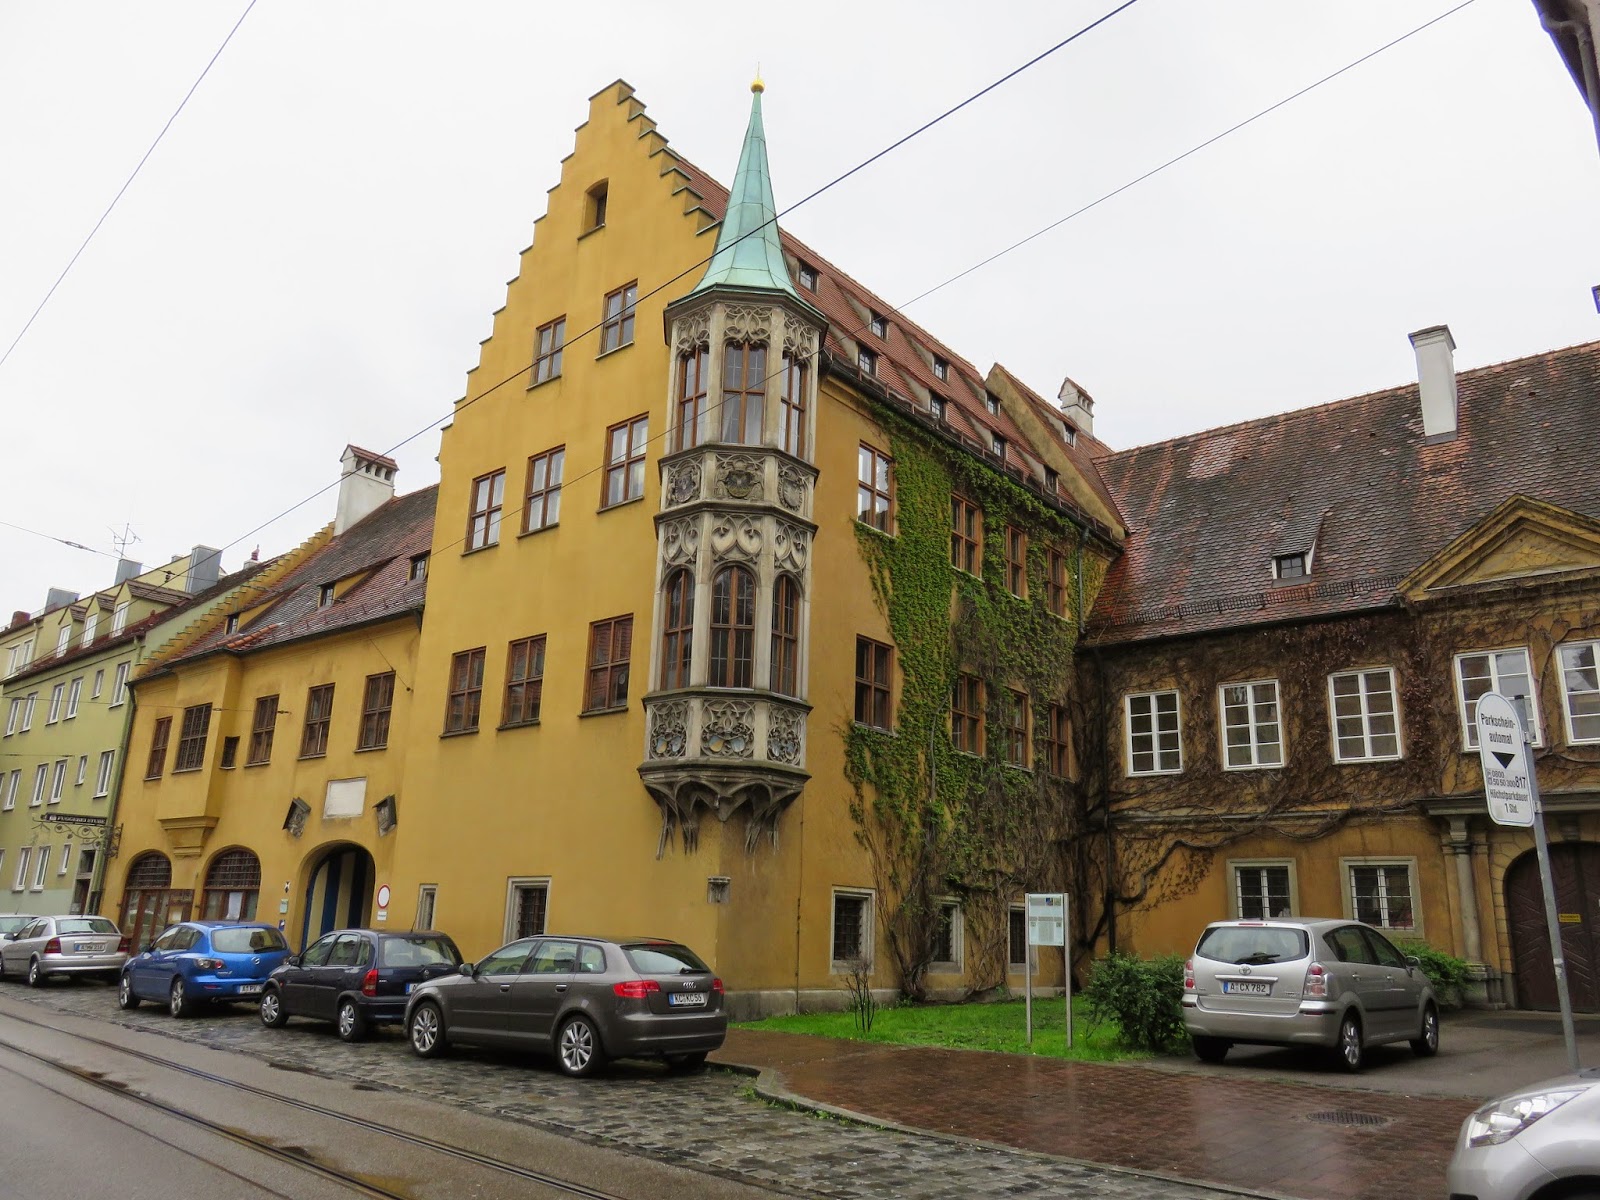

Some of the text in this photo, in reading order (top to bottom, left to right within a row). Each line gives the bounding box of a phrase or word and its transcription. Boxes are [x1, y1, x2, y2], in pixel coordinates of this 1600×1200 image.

[1480, 713, 1516, 729] Parkschein-
[1489, 732, 1513, 744] automat
[1504, 803, 1508, 813] 1
[1239, 983, 1250, 992] CX
[1251, 984, 1266, 993] 782
[674, 993, 683, 1003] KC
